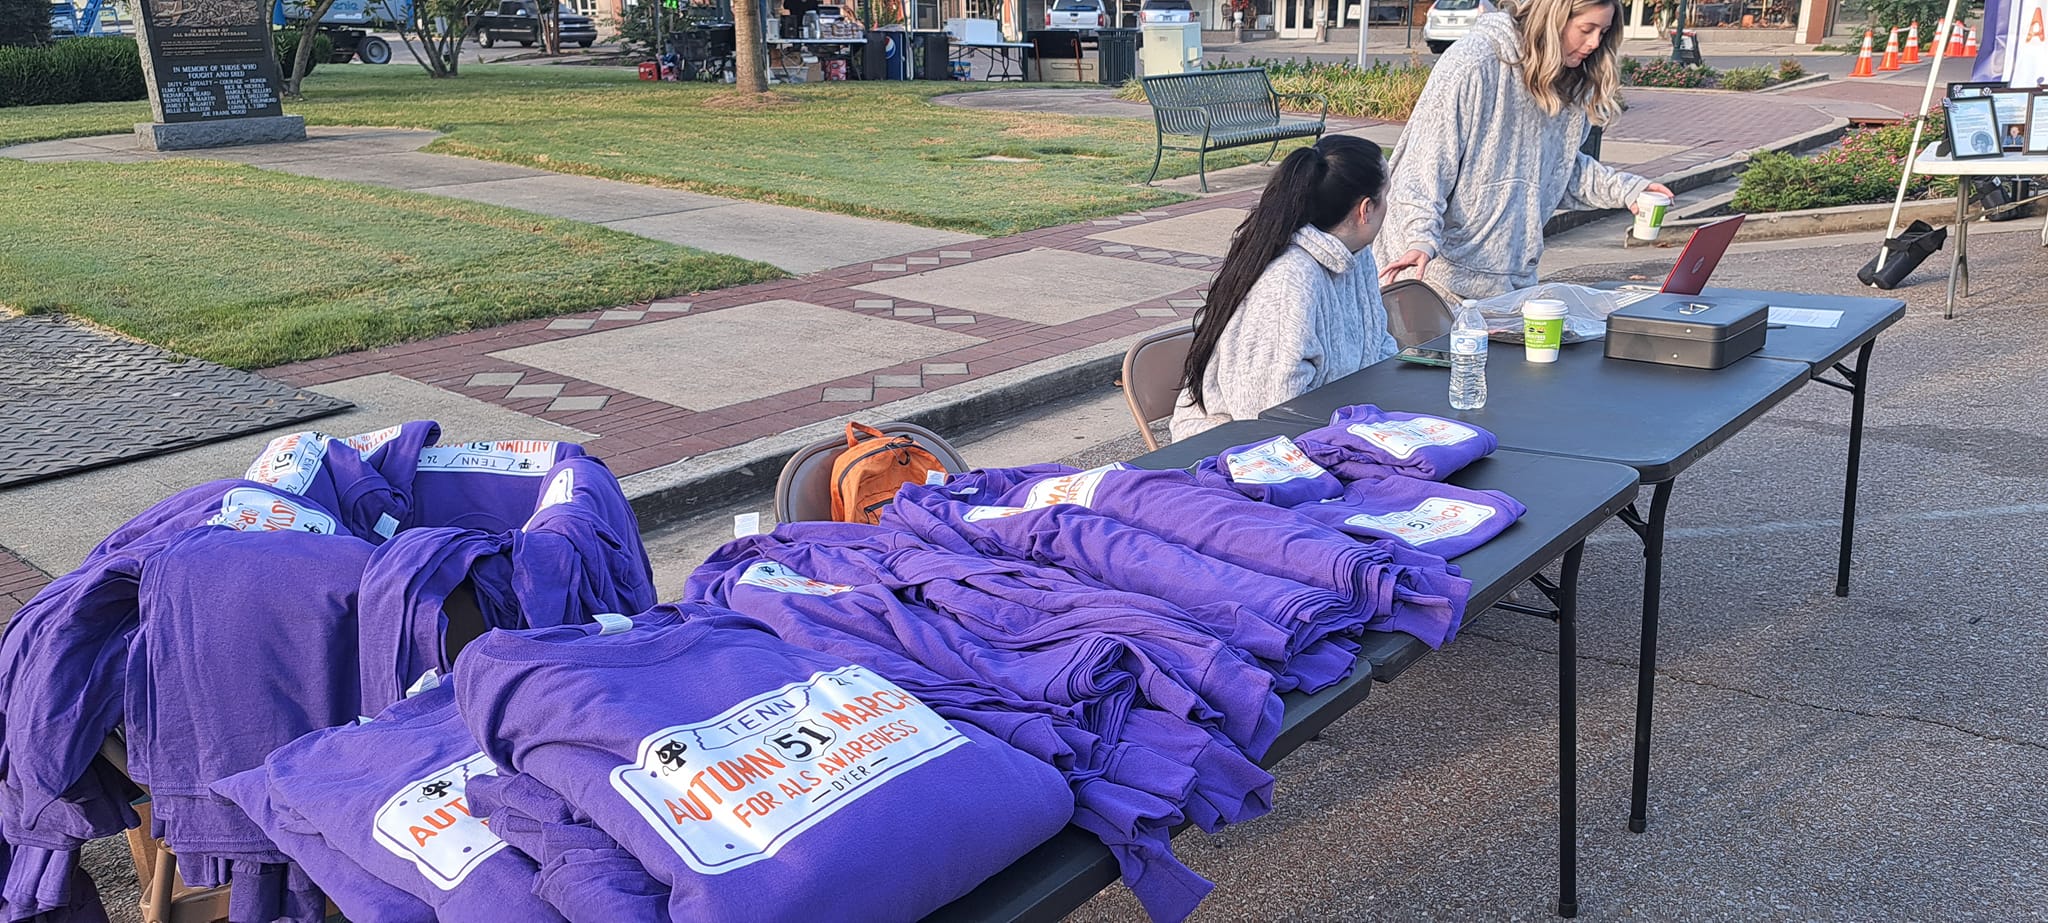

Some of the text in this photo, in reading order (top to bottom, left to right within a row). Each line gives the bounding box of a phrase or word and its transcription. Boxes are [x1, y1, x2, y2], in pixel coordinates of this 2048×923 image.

[188, 71, 213, 79] FOUGHT
[274, 453, 293, 470] 51
[461, 456, 498, 468] TENN
[719, 699, 796, 736] TENN
[821, 688, 922, 731] MARCH
[773, 726, 832, 759] 51
[664, 747, 786, 825] AUTUMN
[732, 719, 919, 828] FOR ALS AWARENESS
[831, 764, 871, 793] DYER
